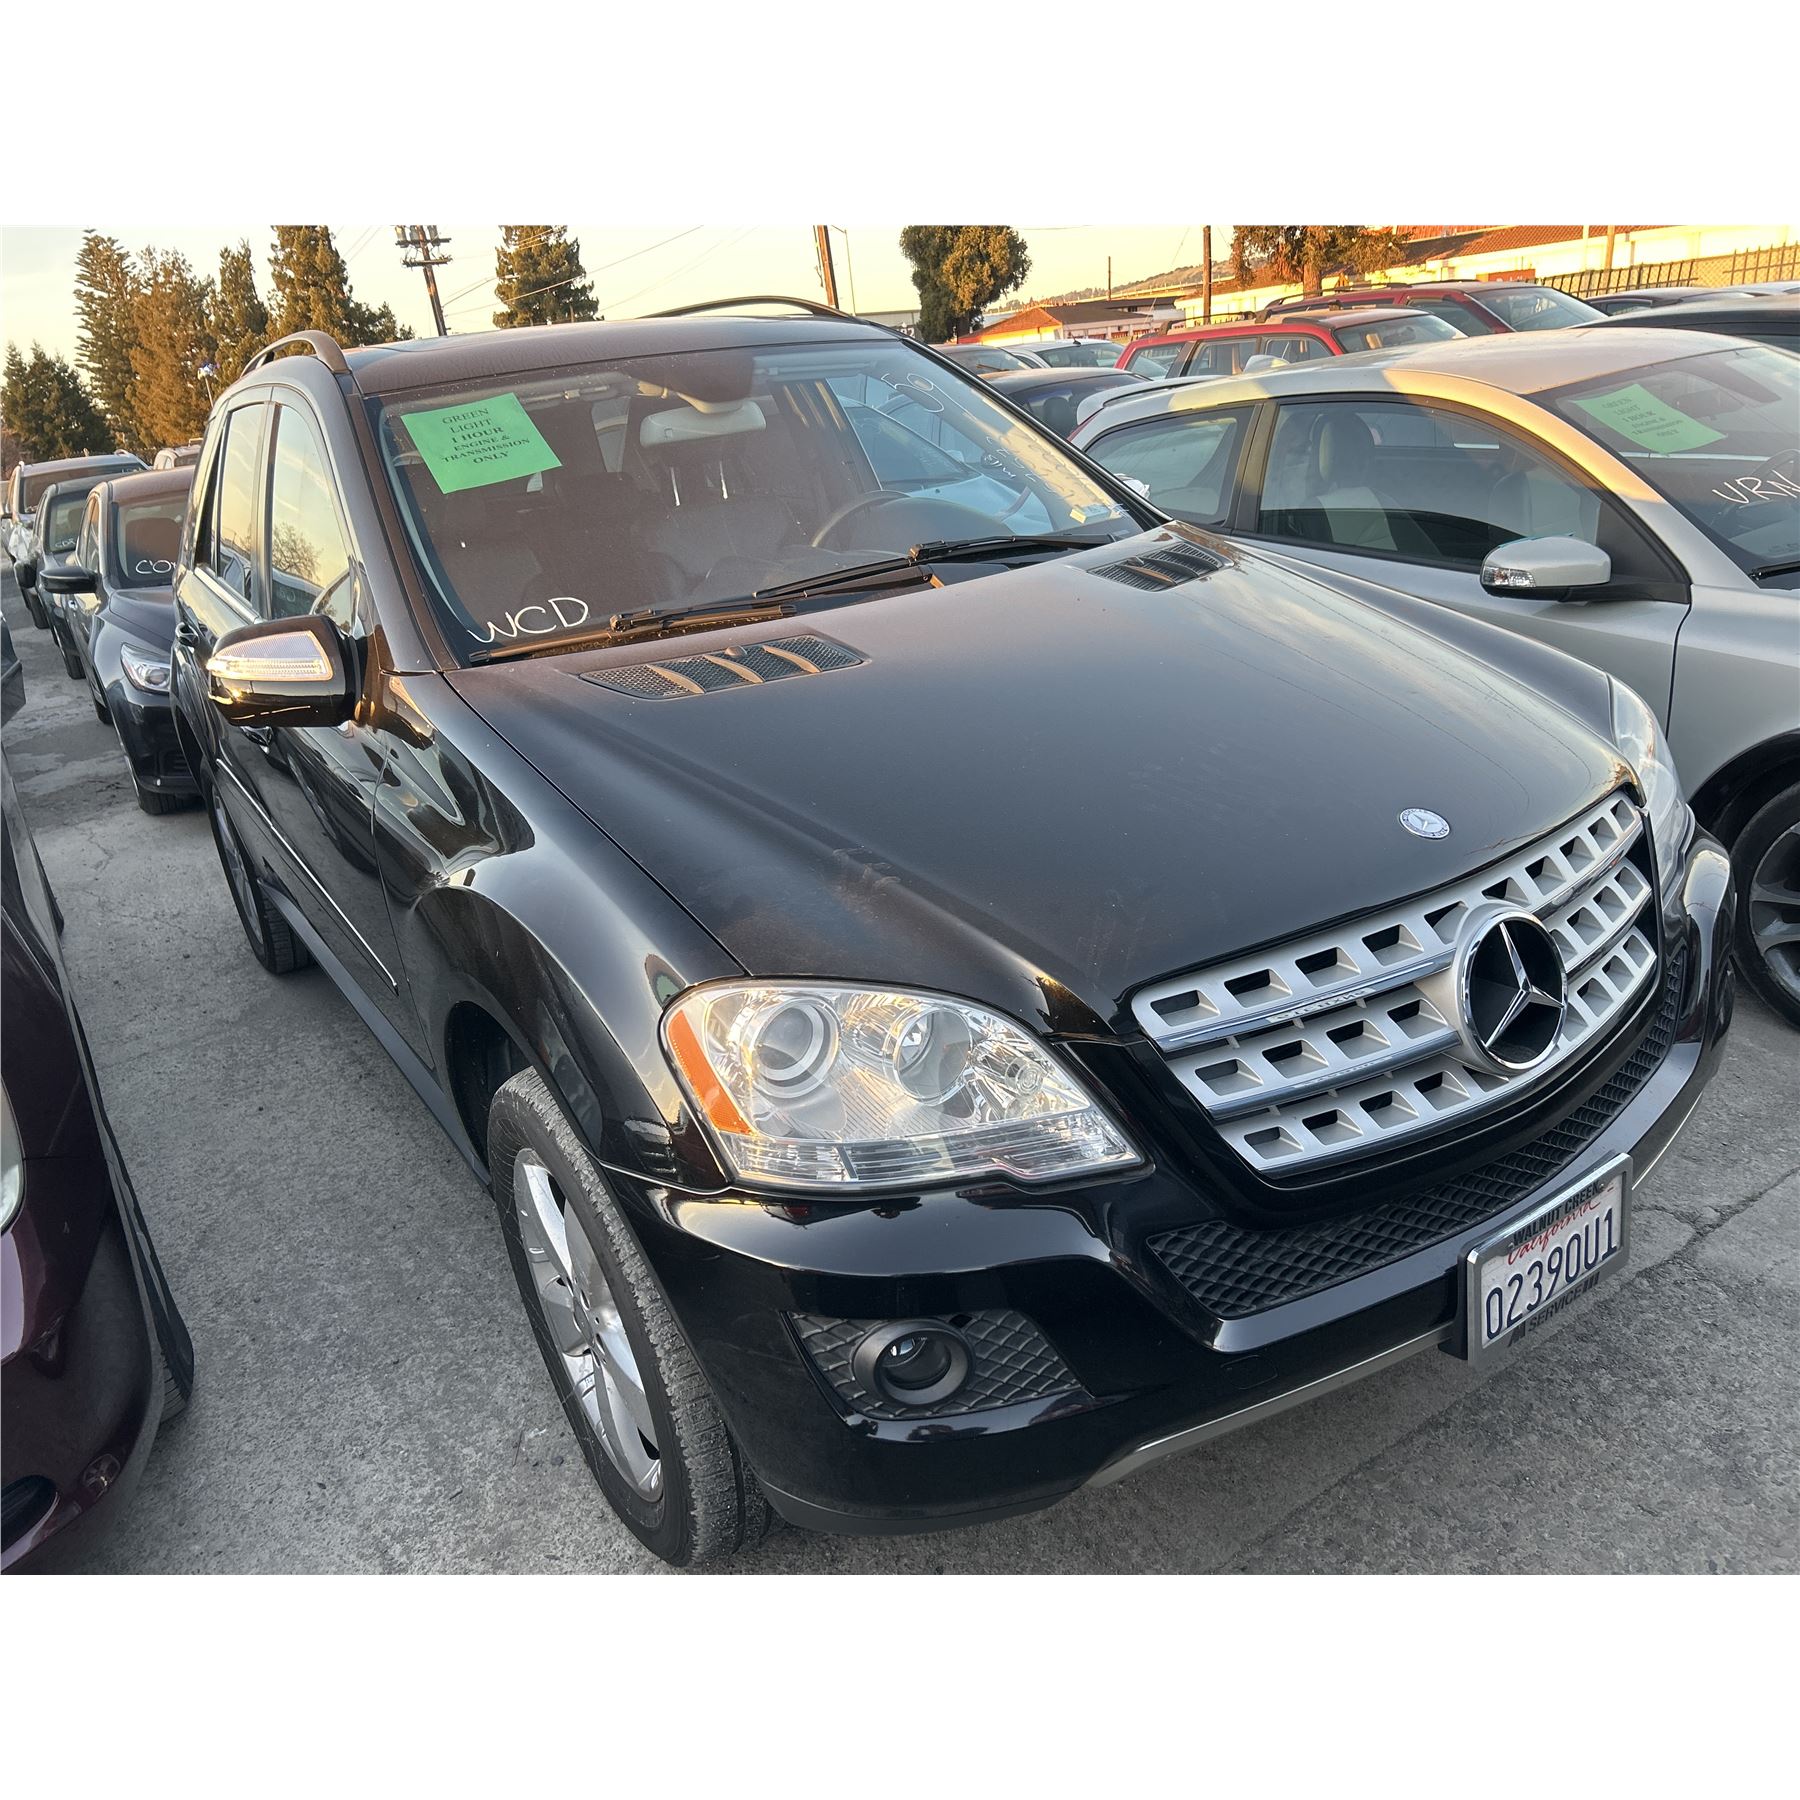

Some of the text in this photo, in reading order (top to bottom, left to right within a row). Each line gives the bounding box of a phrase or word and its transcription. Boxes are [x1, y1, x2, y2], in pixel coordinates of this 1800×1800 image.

[442, 408, 489, 424] GREEN
[450, 418, 492, 434] LIGHT
[454, 437, 499, 451] ENGINE
[461, 427, 504, 441] HOUR
[442, 438, 530, 462] TRANSMISSION
[473, 451, 509, 464] ONLY
[467, 597, 590, 643] WCD
[1512, 1180, 1602, 1246] WALNUT CREEK
[1486, 1208, 1617, 1339] 02390U1
[1528, 1284, 1583, 1332] SERVICE
